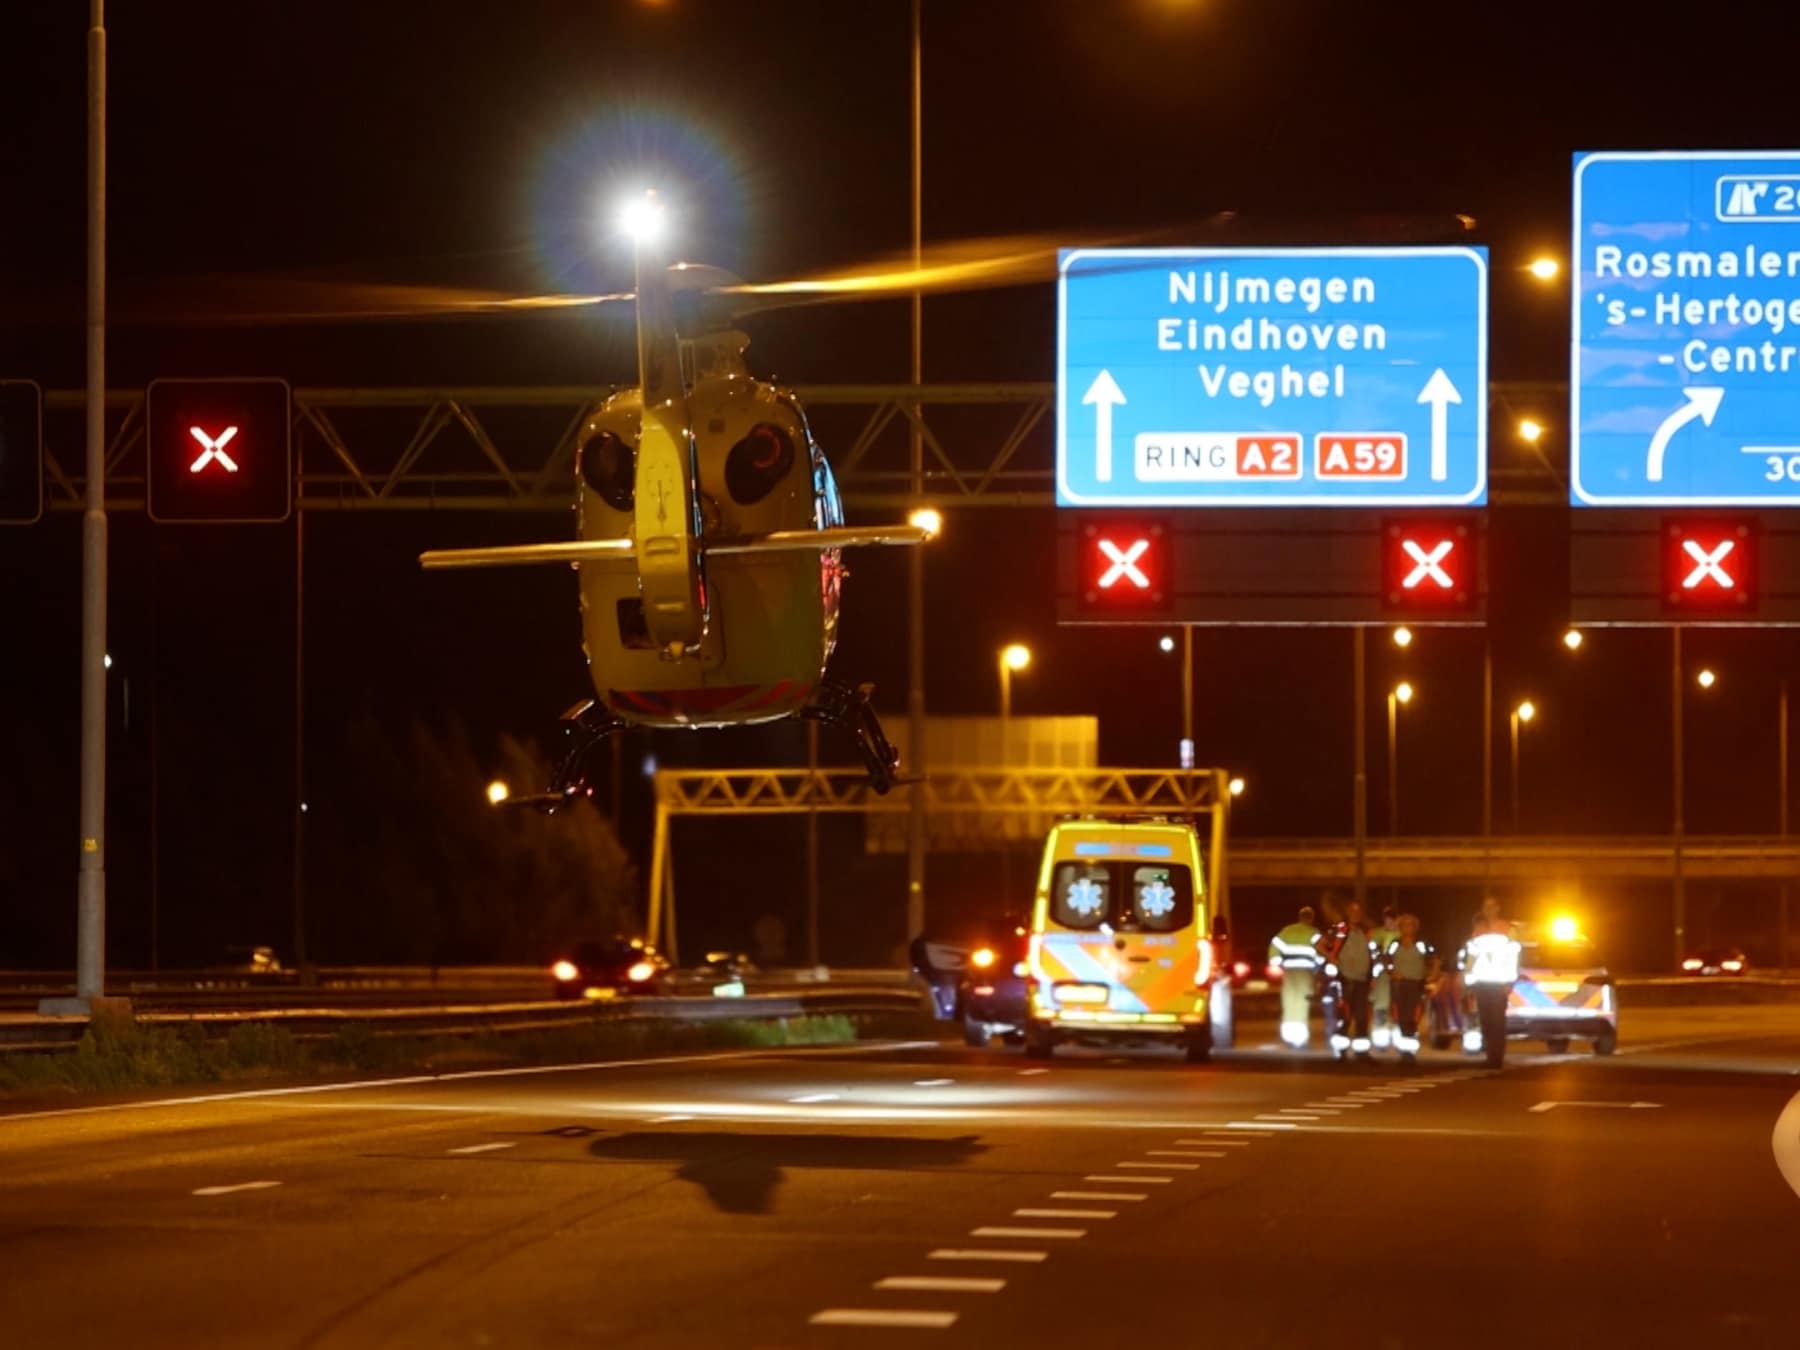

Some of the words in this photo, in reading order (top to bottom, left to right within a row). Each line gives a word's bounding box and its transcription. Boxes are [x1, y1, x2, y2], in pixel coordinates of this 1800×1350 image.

[1774, 186, 1800, 211] 2
[1169, 271, 1375, 313] Nijmegen
[1157, 318, 1386, 351] Eindhoven
[1658, 340, 1800, 372] -Centr
[1198, 364, 1345, 407] Veghel
[1146, 446, 1226, 468] RING
[1241, 442, 1293, 471] A2
[1324, 442, 1397, 471] A59
